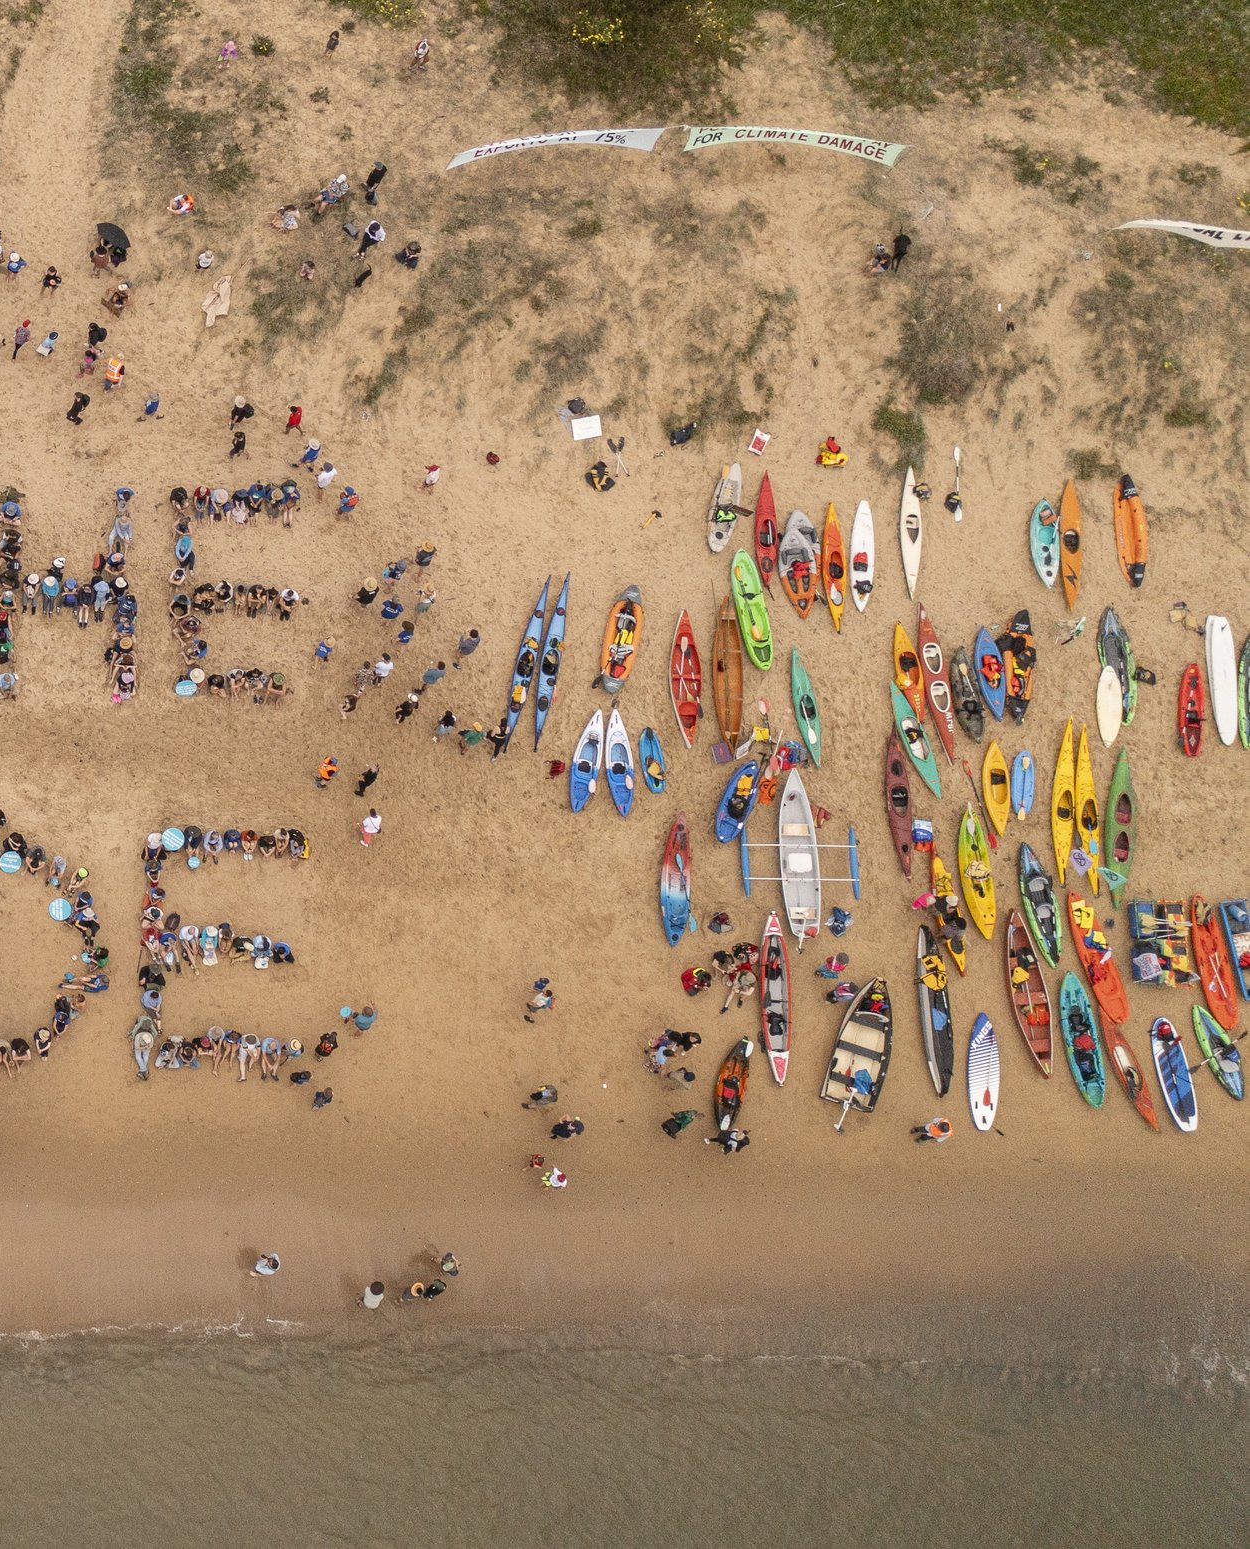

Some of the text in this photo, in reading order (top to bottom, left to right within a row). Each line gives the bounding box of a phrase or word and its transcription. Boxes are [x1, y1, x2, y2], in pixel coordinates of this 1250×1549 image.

[693, 132, 723, 146] FOR
[735, 128, 808, 142] CLIMATE
[817, 134, 887, 160] DAMAGE
[971, 1020, 993, 1049] KINGS
